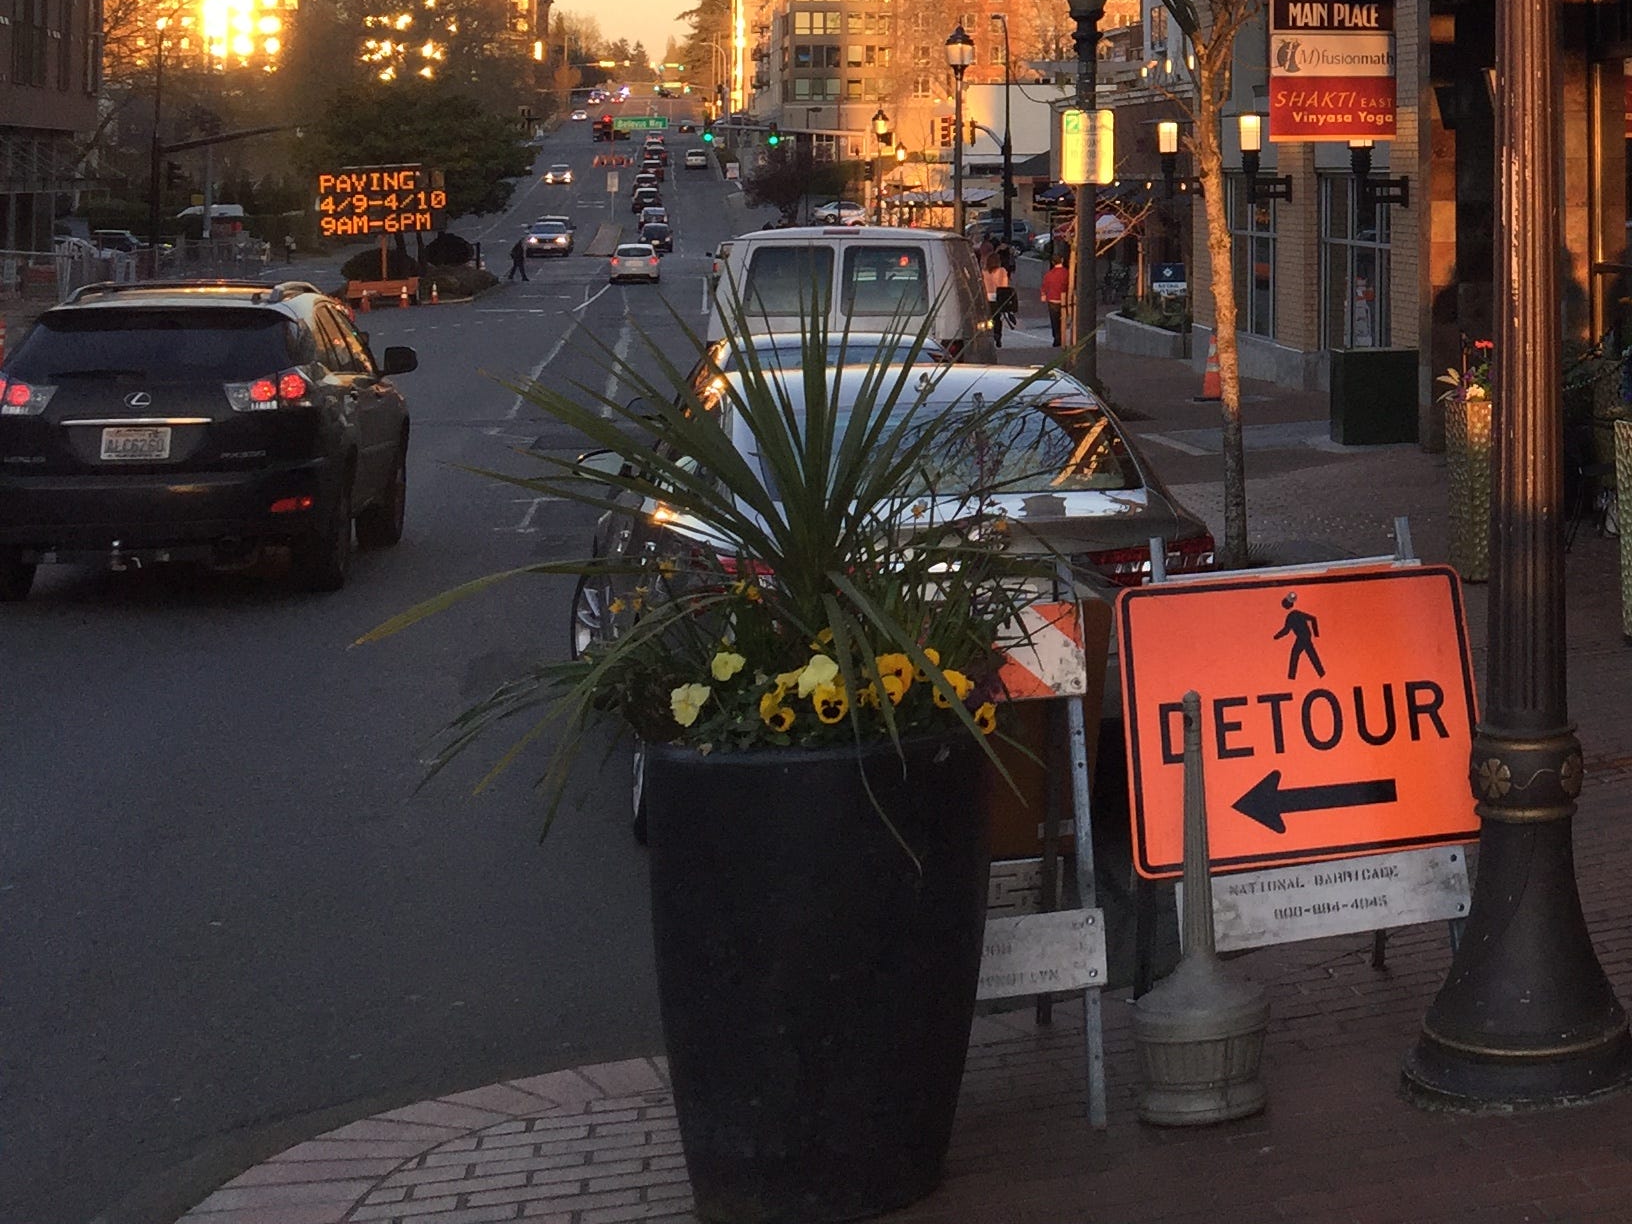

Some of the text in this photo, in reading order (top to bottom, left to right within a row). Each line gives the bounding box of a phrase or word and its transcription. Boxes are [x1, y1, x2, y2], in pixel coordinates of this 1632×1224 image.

[1288, 2, 1379, 27] MAIN PLACE
[1275, 91, 1393, 108] SHAKTI EAST
[1292, 111, 1393, 126] Vinyasa Yoga
[319, 171, 415, 194] PAVING
[320, 190, 446, 214] 4/9-4/10
[320, 211, 431, 236] 9AM-6PM
[1159, 679, 1451, 765] DETOUR
[1229, 865, 1400, 896] NATIONAL BARRICADE
